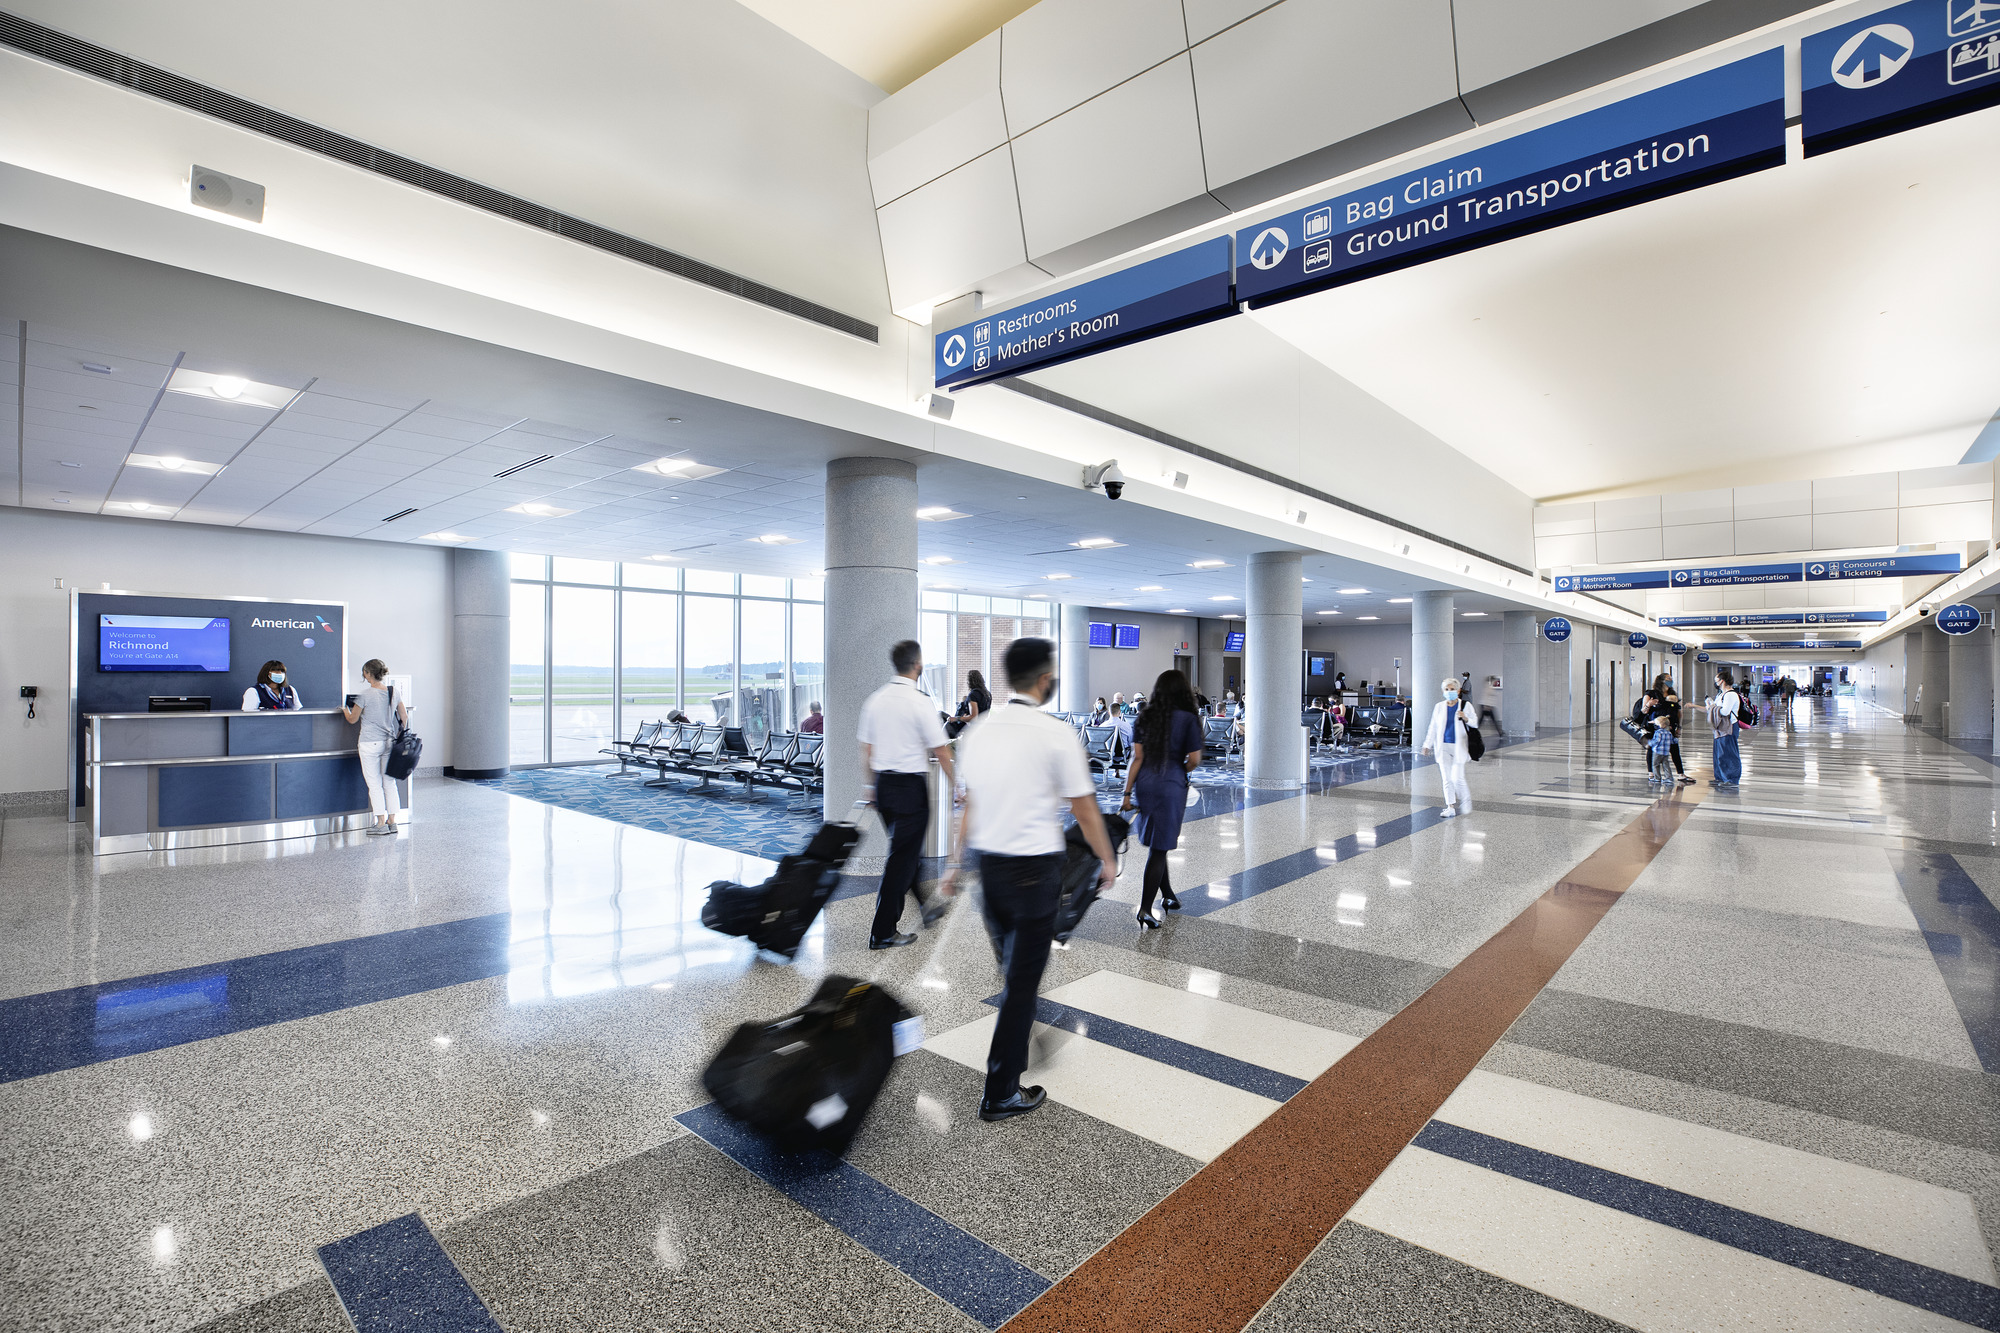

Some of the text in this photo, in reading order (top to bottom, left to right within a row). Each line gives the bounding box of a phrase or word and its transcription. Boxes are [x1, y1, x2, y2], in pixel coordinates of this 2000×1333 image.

[1346, 164, 1483, 224] Bag Claim
[1346, 133, 1710, 256] Ground Transportation
[998, 299, 1077, 336] Restrooms
[997, 312, 1119, 361] Mother's Room
[1843, 560, 1887, 569] Concourse
[1843, 569, 1883, 577] Ticketing
[1733, 574, 1790, 583] Transportation
[1583, 582, 1612, 590] Mother's
[1948, 610, 1970, 618] A11
[250, 617, 315, 629] American
[109, 640, 169, 650] Richmond
